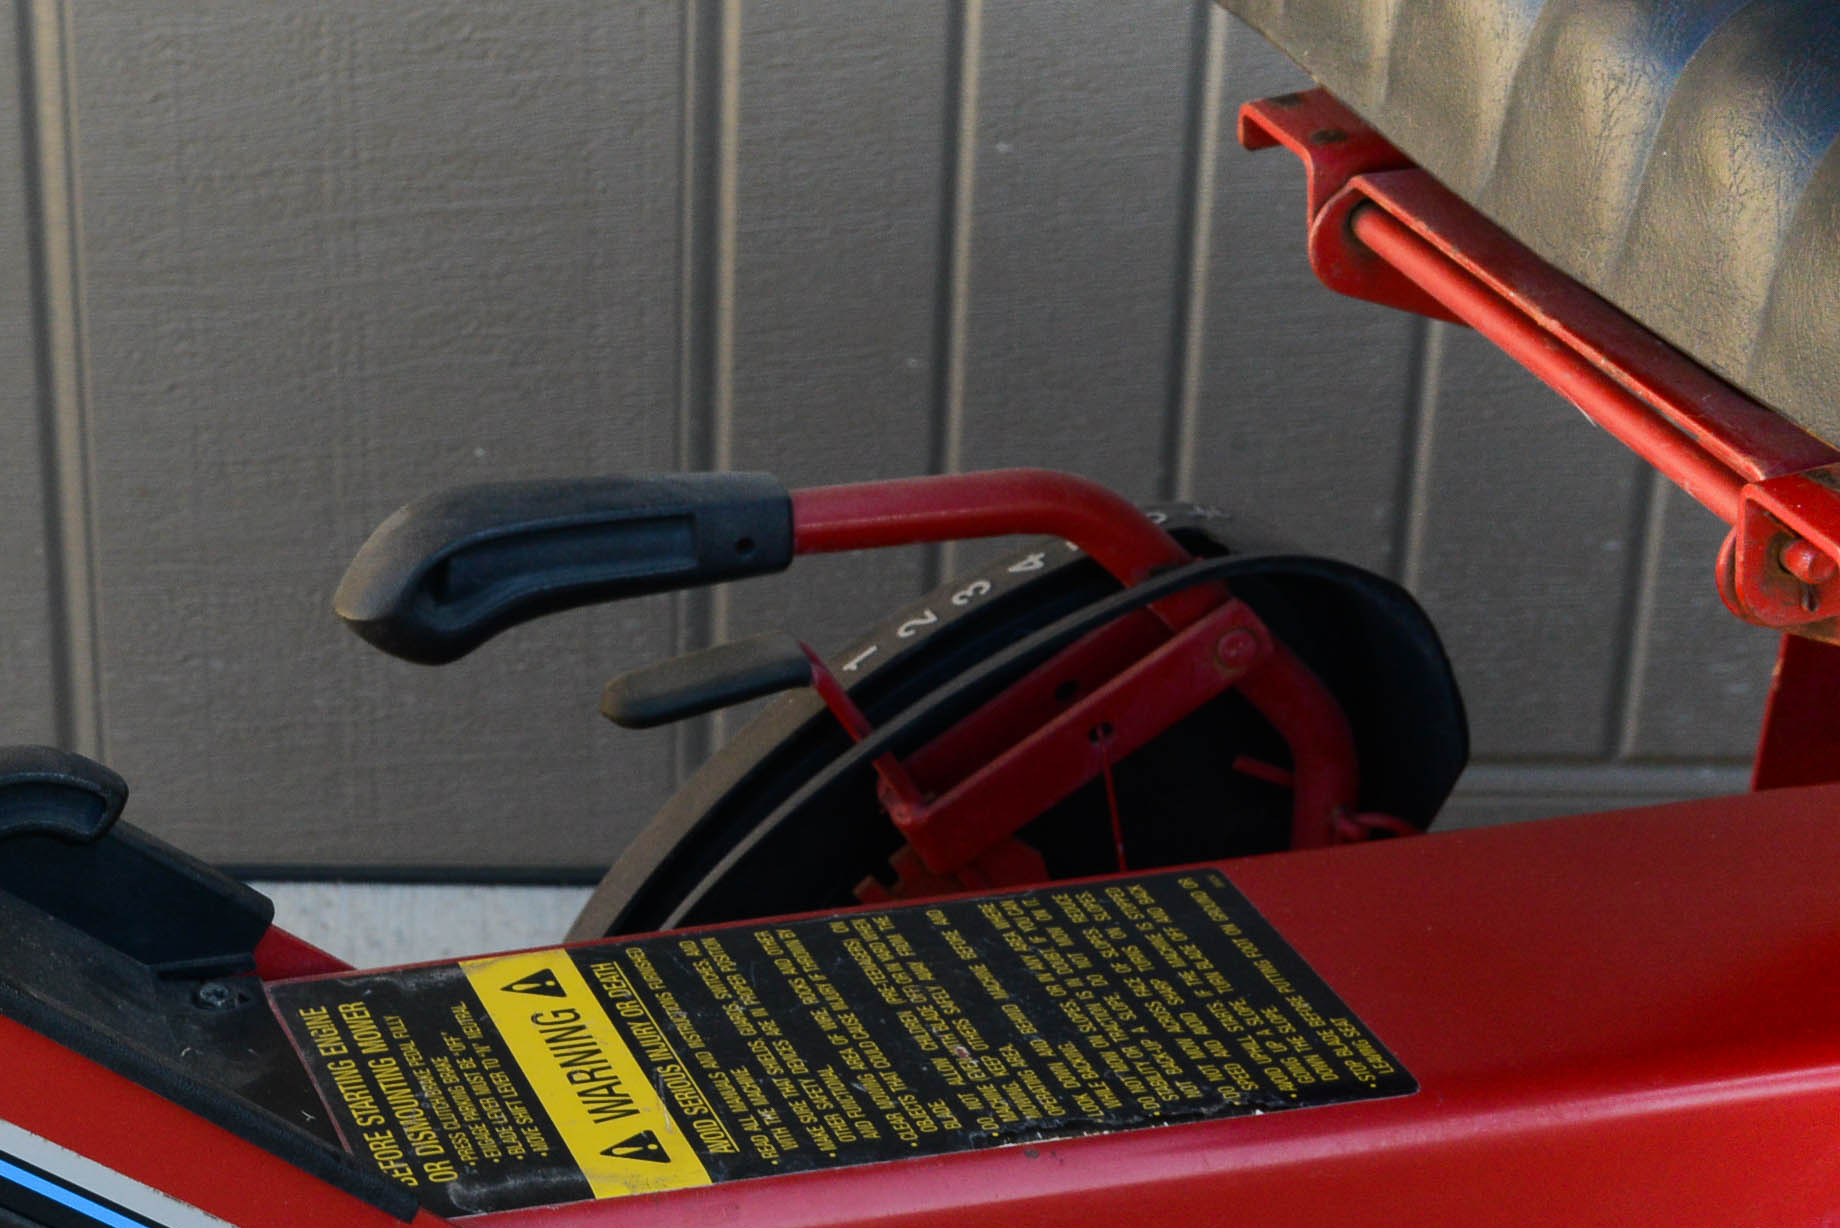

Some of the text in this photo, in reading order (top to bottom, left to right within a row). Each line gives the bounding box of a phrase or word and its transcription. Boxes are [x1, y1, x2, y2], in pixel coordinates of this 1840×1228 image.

[843, 552, 1045, 671] 1 2 3 4
[870, 915, 896, 930] THE
[699, 937, 739, 972] POSITION
[725, 973, 762, 1005] PROPER
[807, 972, 828, 981] IF
[925, 984, 962, 1014] SAFELY
[1283, 994, 1328, 1027] BEFORE
[296, 1005, 349, 1056] ENGINE
[382, 1014, 410, 1038] FULLY
[757, 1019, 784, 1036] ARE
[837, 1012, 871, 1039] CAUSE
[895, 1010, 940, 1051] CHILDREN
[915, 1004, 950, 1031] BLADE
[1129, 1025, 1150, 1033] A
[1328, 1016, 1363, 1038] SEAT
[676, 939, 839, 1151] MAKE SURE THAT AND
[751, 930, 920, 1140] CLEAR MOWING AREA OF ROCKS AND OTHER
[951, 1018, 991, 1050] OTHERS
[1086, 1034, 1111, 1048] ON
[1253, 1028, 1275, 1036] A
[1284, 1034, 1315, 1052] THE
[1315, 1028, 1355, 1057] BLADE
[397, 1039, 426, 1066] PEDAL
[588, 962, 735, 1154] AVOID SERIOUS INJURY OR DEATH
[622, 946, 781, 1158] READ ALL MANUALS AND INSTRUCTIONS FURNISHED
[771, 1039, 811, 1074] DEVICES
[857, 1040, 893, 1068] COULD
[1028, 1038, 1057, 1057] AND
[1233, 1034, 1274, 1064] UPHILL
[1263, 1039, 1290, 1053] UP
[456, 1057, 477, 1069] BE
[480, 1057, 503, 1069] TO
[526, 1008, 643, 1123] WARNING
[930, 1056, 967, 1086] ALLOW
[979, 1054, 1011, 1076] KEEP
[1047, 1061, 1083, 1088] DOWN
[1221, 1061, 1261, 1090] SPEED
[1342, 1058, 1378, 1081] STOP
[325, 1059, 386, 1126] STARTING
[336, 1001, 461, 1183] OR DISMOUNTING MOWER
[464, 1071, 492, 1094] MUST
[488, 1071, 520, 1097] LEVER
[798, 1076, 836, 1109] SAFETY
[879, 1070, 910, 1091] THAT
[1015, 1068, 1068, 1116] OPERATING
[1120, 1075, 1149, 1093] NOT
[1132, 1060, 1181, 1101] STABILITY
[1215, 1085, 1242, 1098] DO
[430, 1055, 504, 1157] ENGAGE PARKING BRAKE
[958, 1092, 985, 1109] NOT
[976, 1083, 1021, 1122] MACHINE
[1072, 1092, 1106, 1117] LOOK
[1087, 1081, 1124, 1108] WHILE
[1136, 1095, 1163, 1109] DO
[479, 1097, 510, 1124] LEVER
[505, 1099, 535, 1124] SHIFT
[757, 1107, 783, 1124] THE
[897, 1094, 940, 1132] OBJECTS
[975, 1115, 1001, 1130] DO
[496, 1126, 528, 1154] BLADE
[521, 1125, 552, 1151] MOVE
[771, 1126, 800, 1149] WITH
[823, 1112, 859, 1142] OTHER
[853, 1119, 882, 1139] AND
[448, 1132, 478, 1161] PRESS
